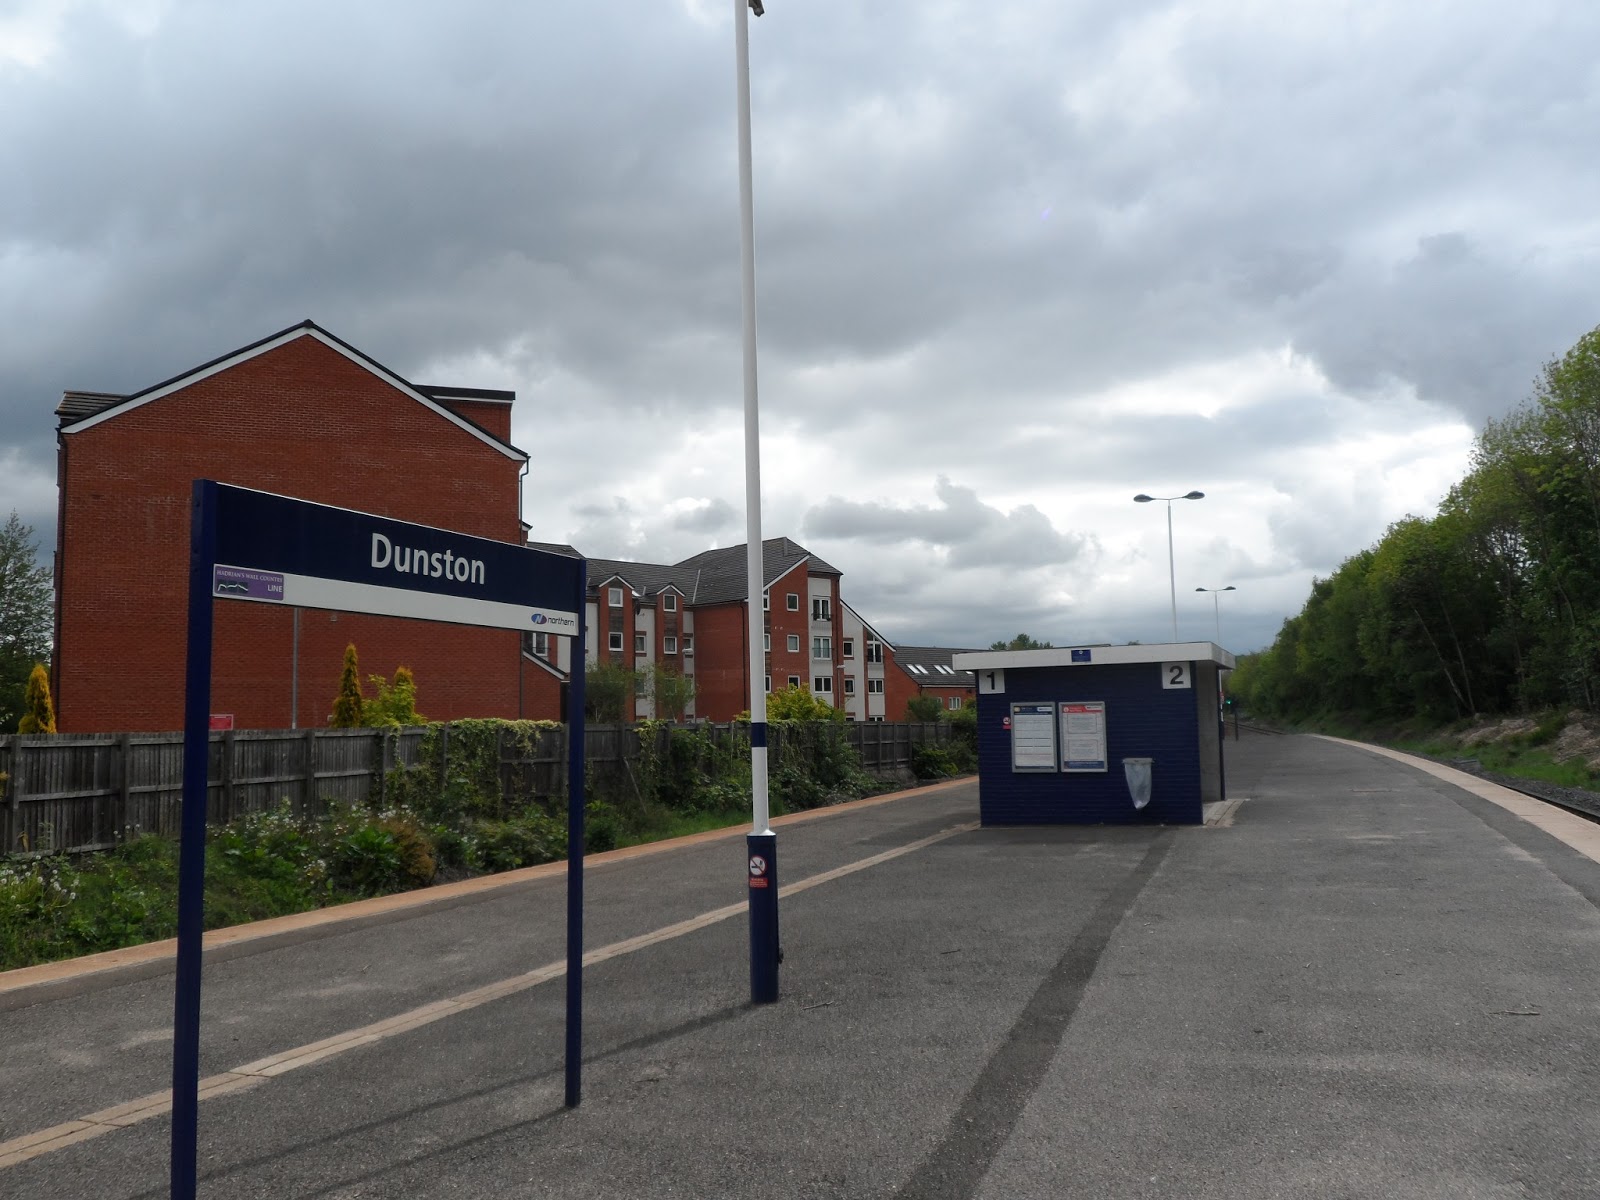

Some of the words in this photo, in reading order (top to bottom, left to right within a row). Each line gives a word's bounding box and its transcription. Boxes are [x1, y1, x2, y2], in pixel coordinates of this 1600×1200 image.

[371, 532, 485, 585] Dunston
[216, 570, 244, 578] HADRIAN'S
[267, 584, 283, 592] LINE
[547, 616, 575, 627] northern
[986, 671, 996, 691] 1
[1169, 665, 1184, 685] 2
